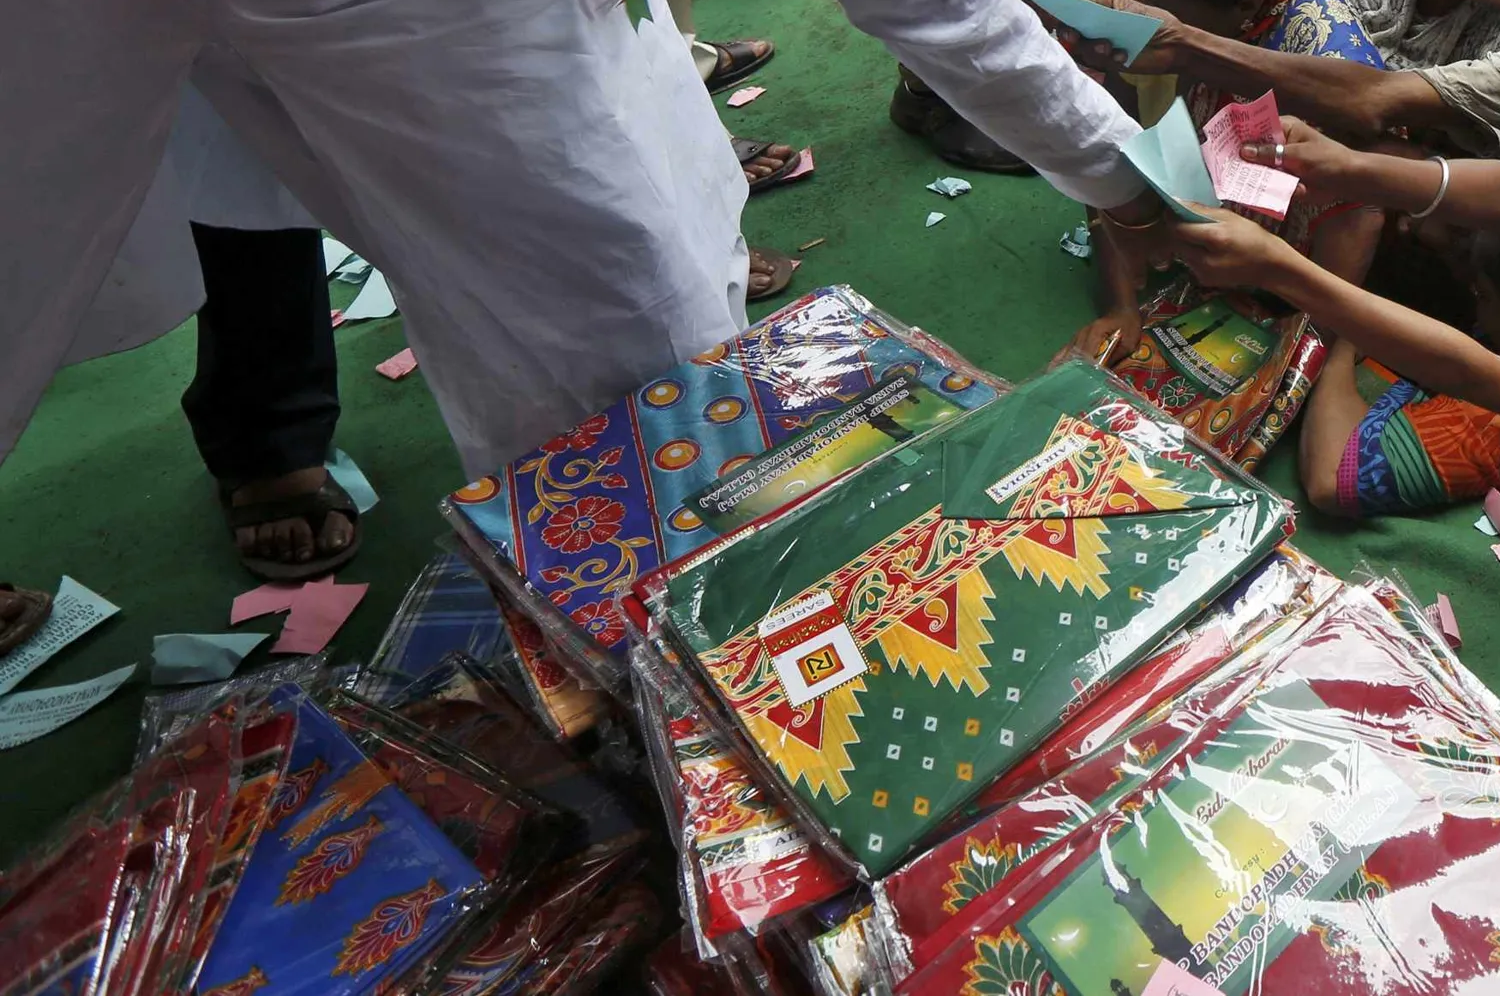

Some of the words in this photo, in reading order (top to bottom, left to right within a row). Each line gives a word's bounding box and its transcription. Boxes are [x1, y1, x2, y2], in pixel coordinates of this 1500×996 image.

[862, 376, 908, 409] NAINA
[866, 387, 911, 420] SUDIP
[754, 402, 866, 475] BANDOPADHYAY
[755, 412, 871, 488] BANDOPADHYAY
[696, 467, 757, 510] (M.L.A.)
[999, 461, 1043, 494] INDIA
[715, 480, 760, 513] (M.P.)
[765, 598, 826, 631] SAREES
[39, 622, 76, 651] WARD
[1194, 791, 1229, 826] Eid
[1187, 820, 1329, 968] BANDOPADHYAY
[1202, 839, 1345, 995] BANDOPADHYAY
